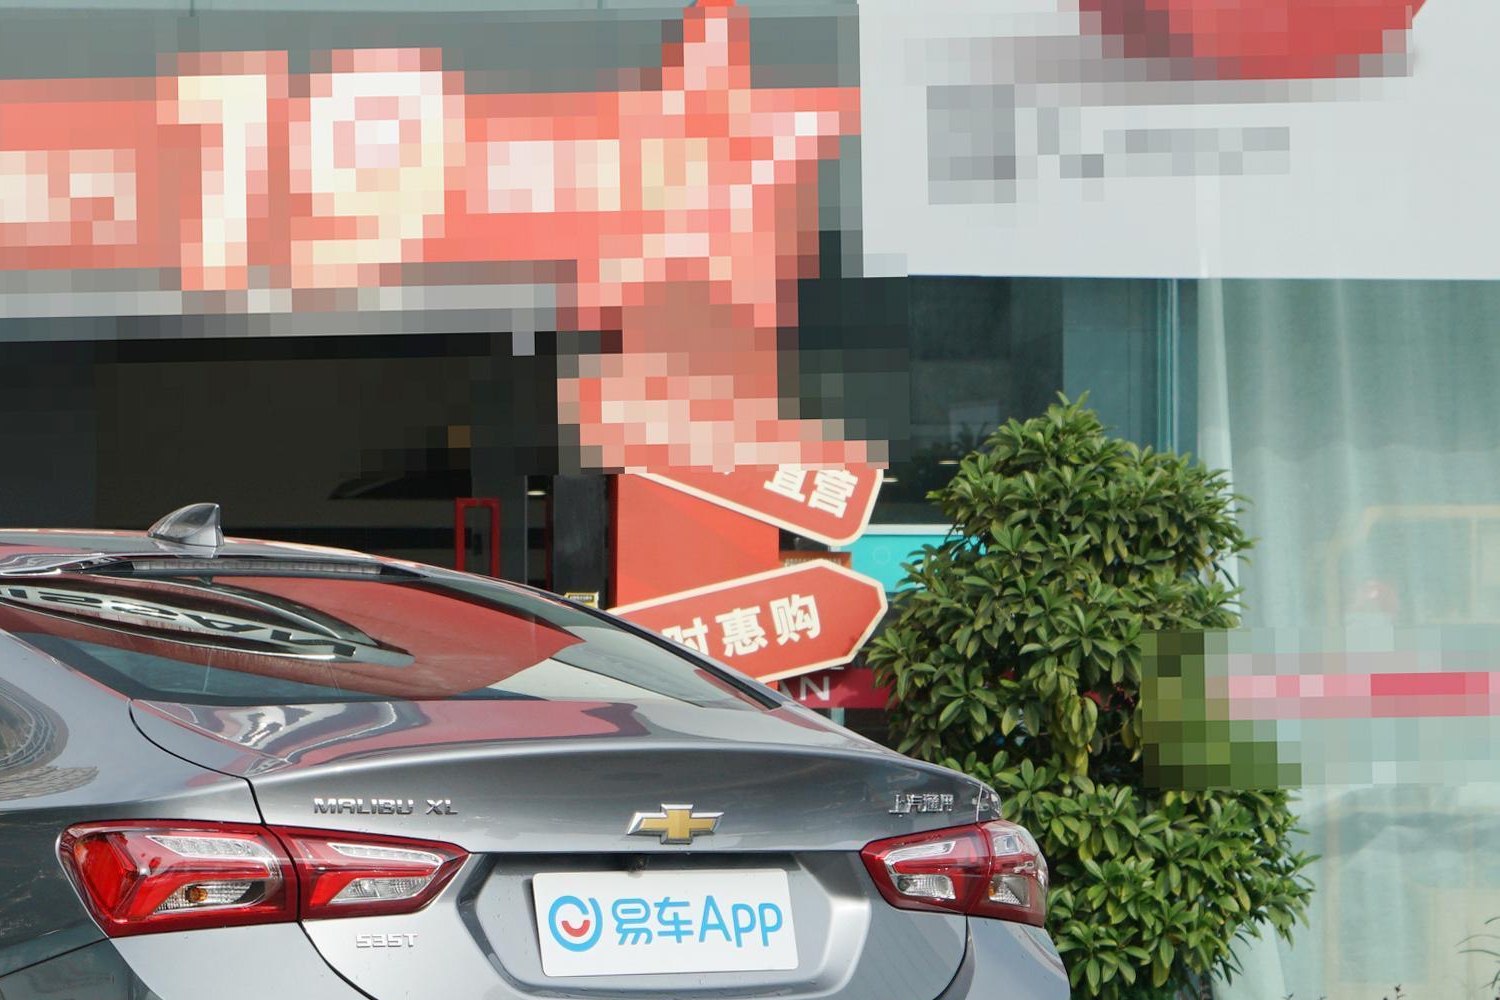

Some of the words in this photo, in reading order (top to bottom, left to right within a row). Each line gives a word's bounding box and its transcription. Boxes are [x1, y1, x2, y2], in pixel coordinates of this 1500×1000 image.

[314, 797, 414, 815] MALIBU
[425, 798, 459, 815] XL
[612, 895, 782, 947] 易车App
[355, 932, 418, 949] 535T
